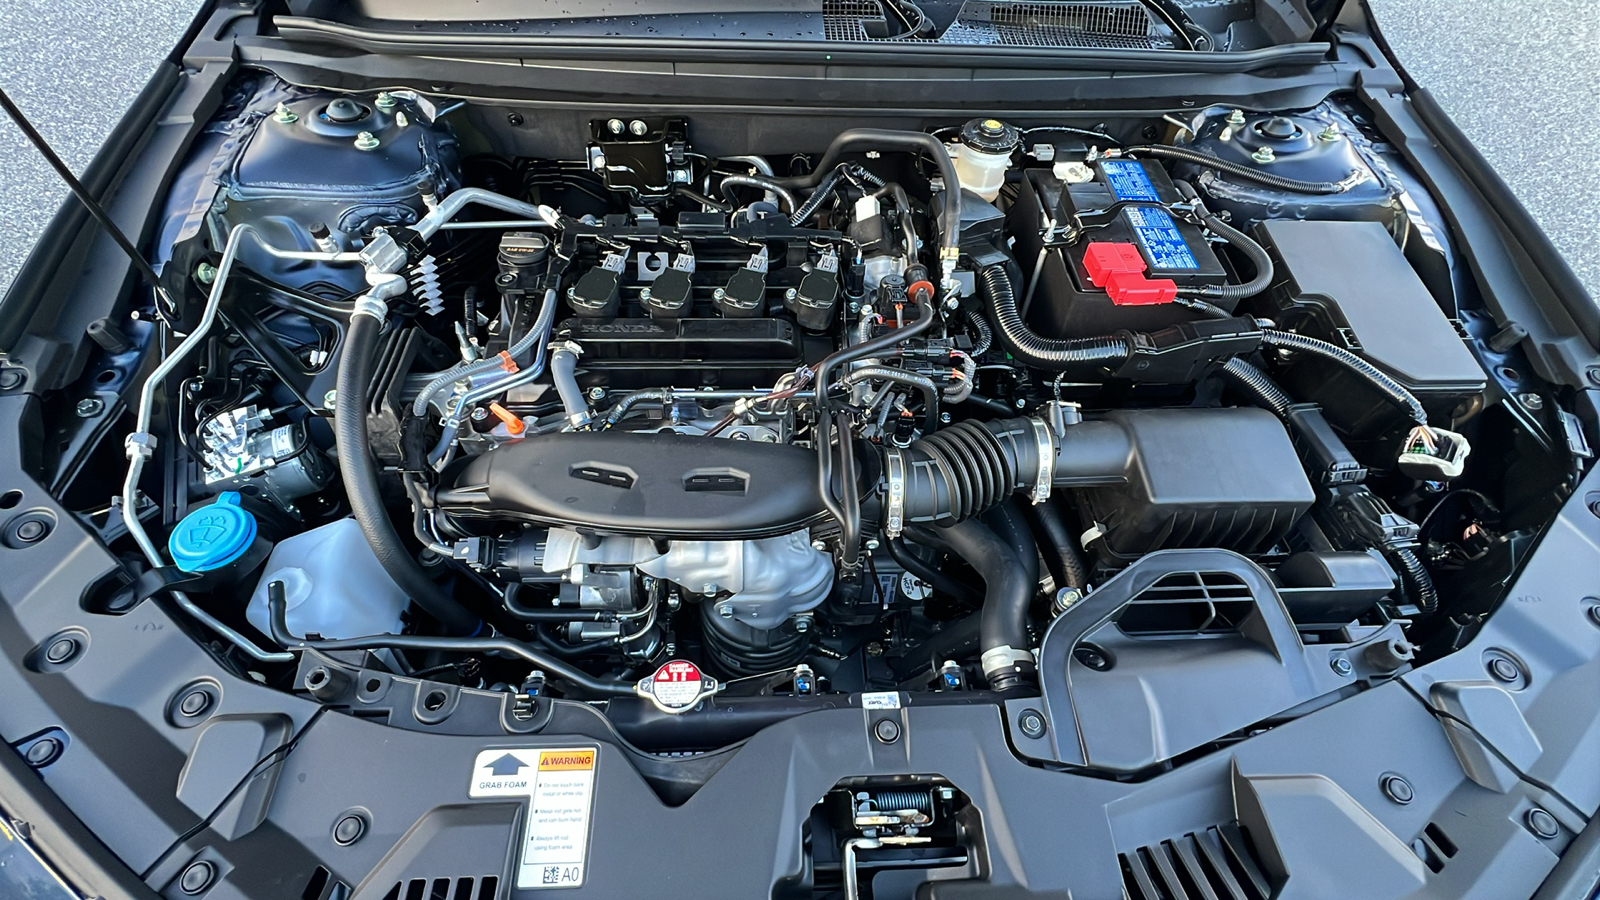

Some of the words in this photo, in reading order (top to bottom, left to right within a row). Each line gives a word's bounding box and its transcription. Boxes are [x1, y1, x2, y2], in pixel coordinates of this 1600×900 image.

[581, 324, 665, 333] HONDA
[550, 756, 591, 765] WARNING
[479, 781, 502, 789] GRAB
[504, 781, 527, 789] FOAM
[561, 867, 579, 882] A0
